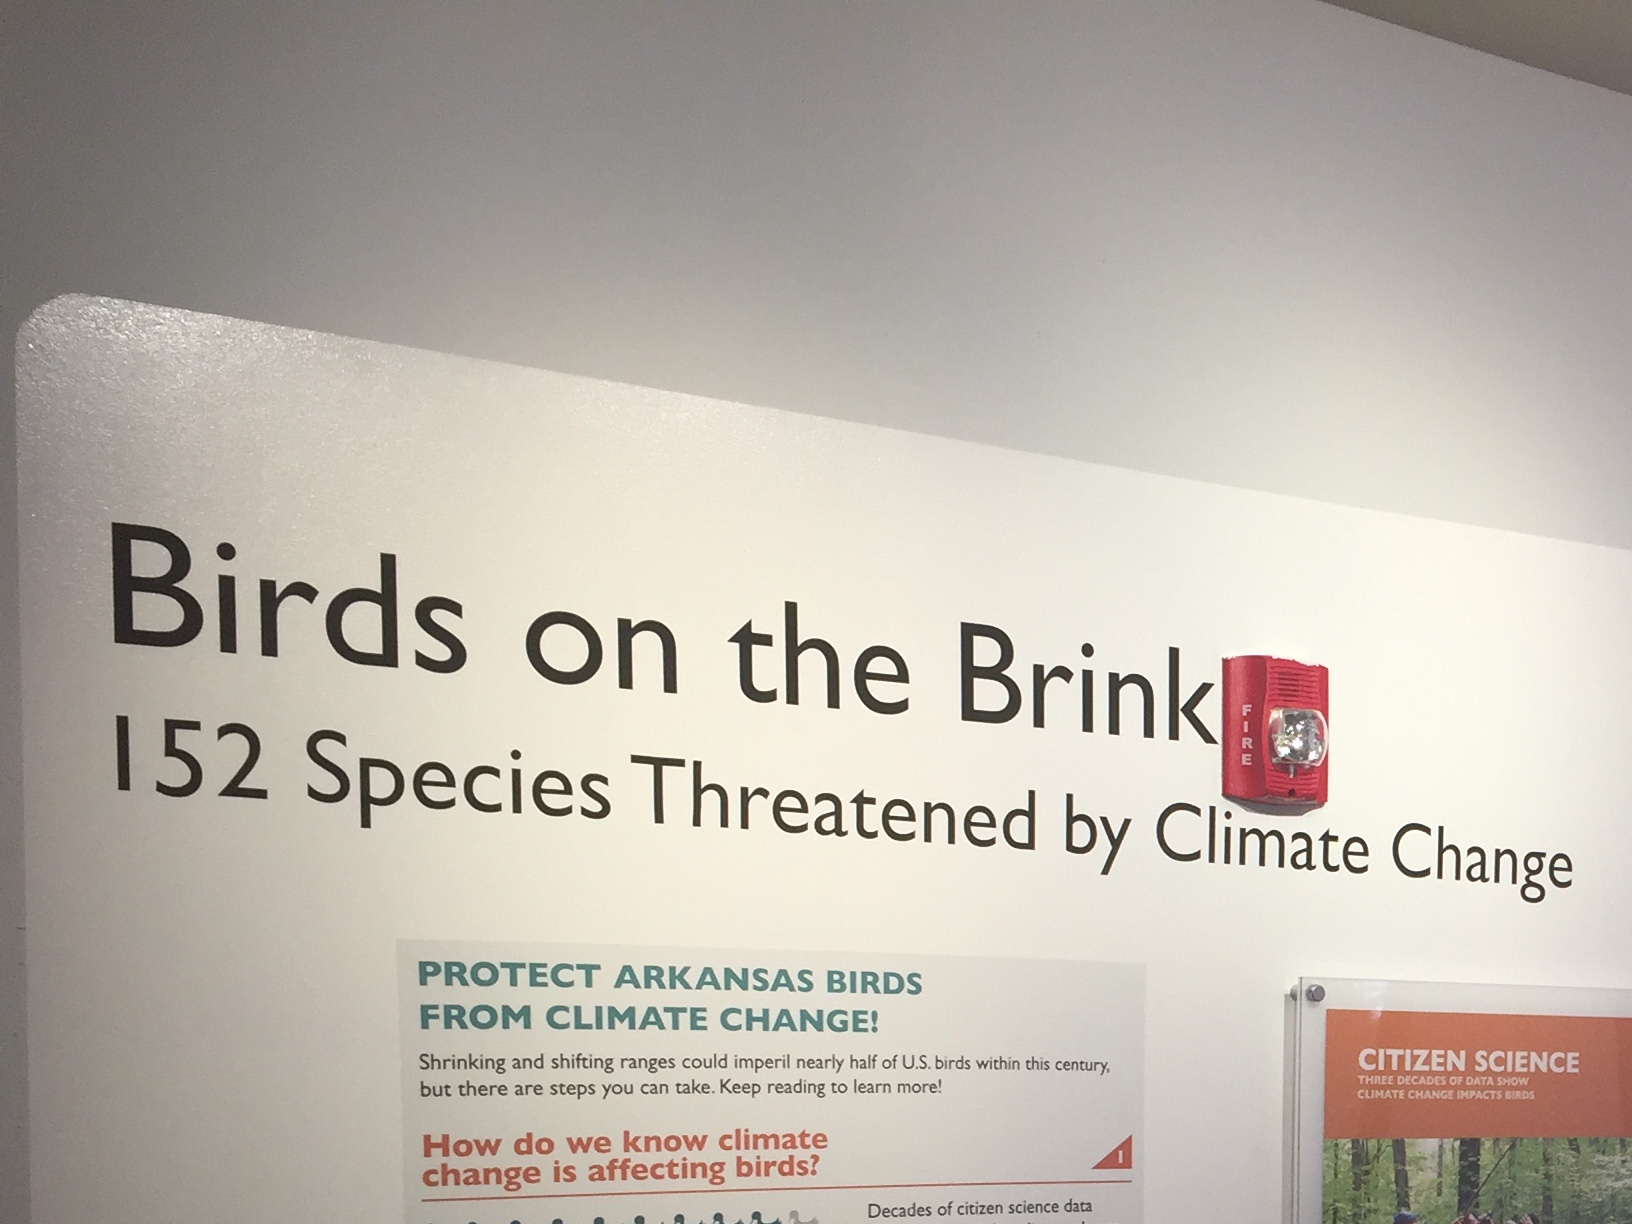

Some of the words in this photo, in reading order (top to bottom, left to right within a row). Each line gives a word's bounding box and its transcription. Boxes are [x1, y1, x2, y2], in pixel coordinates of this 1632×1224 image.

[111, 522, 467, 673] Birds
[526, 611, 677, 694] on
[728, 601, 909, 715] the
[960, 620, 1220, 746] Brink
[1241, 704, 1254, 766] FIRE
[114, 713, 269, 800] 152
[306, 728, 611, 830] Species
[630, 753, 1036, 851] Threatened
[1064, 792, 1133, 877] by
[1156, 802, 1370, 876] Climate
[1392, 823, 1574, 903] Change
[418, 961, 601, 988] PROTECT
[613, 965, 814, 993] ARKANSAS
[827, 970, 922, 995] BIRDS
[420, 1004, 532, 1030] FROM
[546, 1005, 708, 1031] CLIMATE
[720, 1007, 878, 1033] CHANGE!
[419, 1053, 506, 1074] Shrinking
[512, 1053, 544, 1069] and
[551, 1053, 614, 1074] shifting
[620, 1058, 676, 1074] ranges
[682, 1053, 728, 1069] could
[734, 1054, 790, 1073] imperil
[797, 1054, 844, 1074] nearly
[850, 1054, 878, 1069] half
[882, 1054, 898, 1069] of
[902, 1054, 931, 1070] U.S.
[935, 1055, 971, 1070] birds
[976, 1056, 1020, 1070] within
[1025, 1056, 1050, 1071] this
[1055, 1060, 1110, 1076] century,
[1358, 1048, 1466, 1071] CITIZEN
[1475, 1050, 1579, 1073] SCIENCE
[420, 1081, 452, 1097] but
[458, 1080, 508, 1097] there
[514, 1084, 543, 1096] are
[550, 1083, 596, 1100] steps
[602, 1084, 634, 1100] you
[640, 1083, 669, 1095] can
[675, 1079, 715, 1094] take.
[720, 1078, 761, 1098] Keep
[767, 1078, 826, 1098] reading
[831, 1082, 848, 1094] to
[854, 1079, 891, 1094] learn
[897, 1079, 942, 1094] more!
[1357, 1075, 1394, 1085] THREE
[1397, 1075, 1446, 1086] DECADES
[1449, 1076, 1463, 1086] OF
[1466, 1076, 1494, 1086] DATA
[1497, 1076, 1529, 1086] SHOW
[1357, 1089, 1405, 1099] CLIMATE
[1407, 1090, 1454, 1100] CHANGE
[1457, 1090, 1502, 1099] IMPACTS
[1505, 1090, 1535, 1100] BIRDS
[423, 1134, 502, 1158] How
[514, 1132, 555, 1156] do
[566, 1136, 612, 1154] we
[623, 1130, 708, 1153] know
[718, 1128, 828, 1151] climate
[422, 1163, 541, 1191] change
[553, 1160, 577, 1183] is
[588, 1157, 726, 1186] affecting
[736, 1154, 820, 1177] birds?
[868, 1202, 932, 1218] Decades
[937, 1201, 953, 1216] of
[957, 1201, 1003, 1216] citizen
[1008, 1200, 1059, 1214] science
[1064, 1198, 1093, 1213] data
